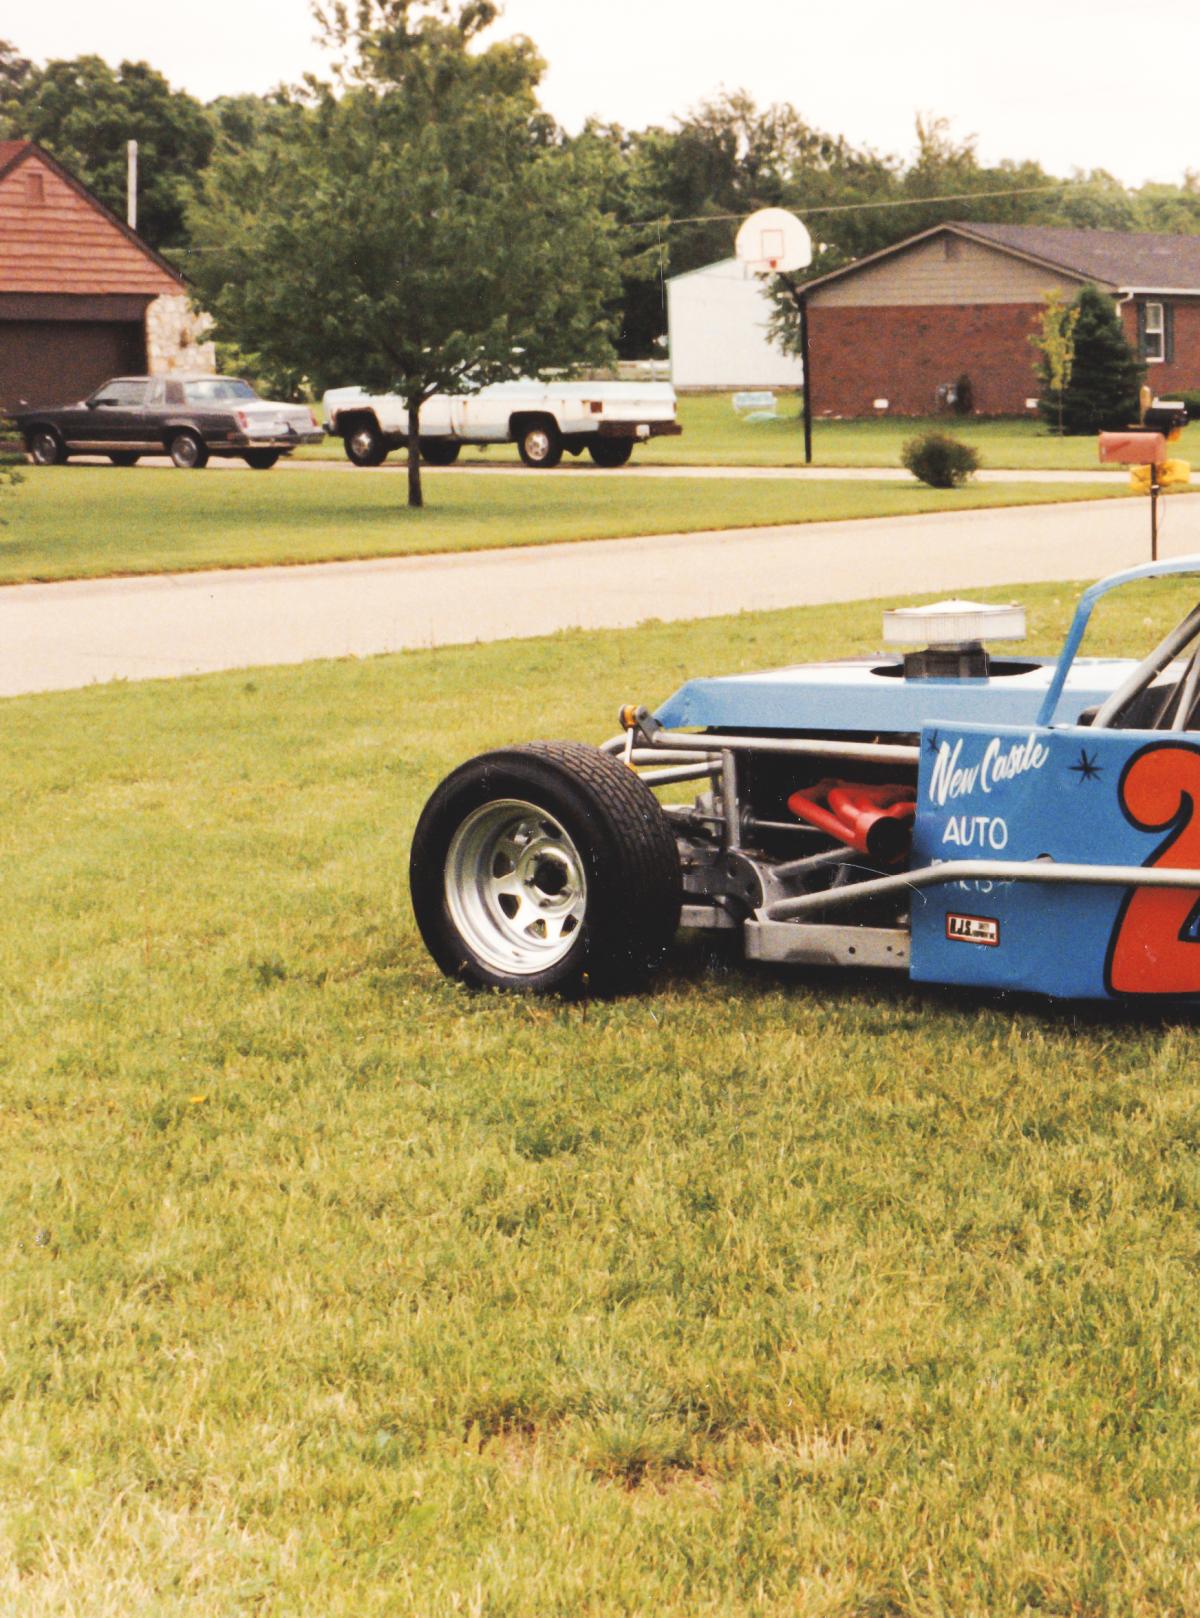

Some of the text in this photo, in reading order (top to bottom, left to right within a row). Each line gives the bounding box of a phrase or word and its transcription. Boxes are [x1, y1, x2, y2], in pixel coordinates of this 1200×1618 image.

[929, 731, 1051, 806] New Castle
[941, 815, 1008, 850] AUTO
